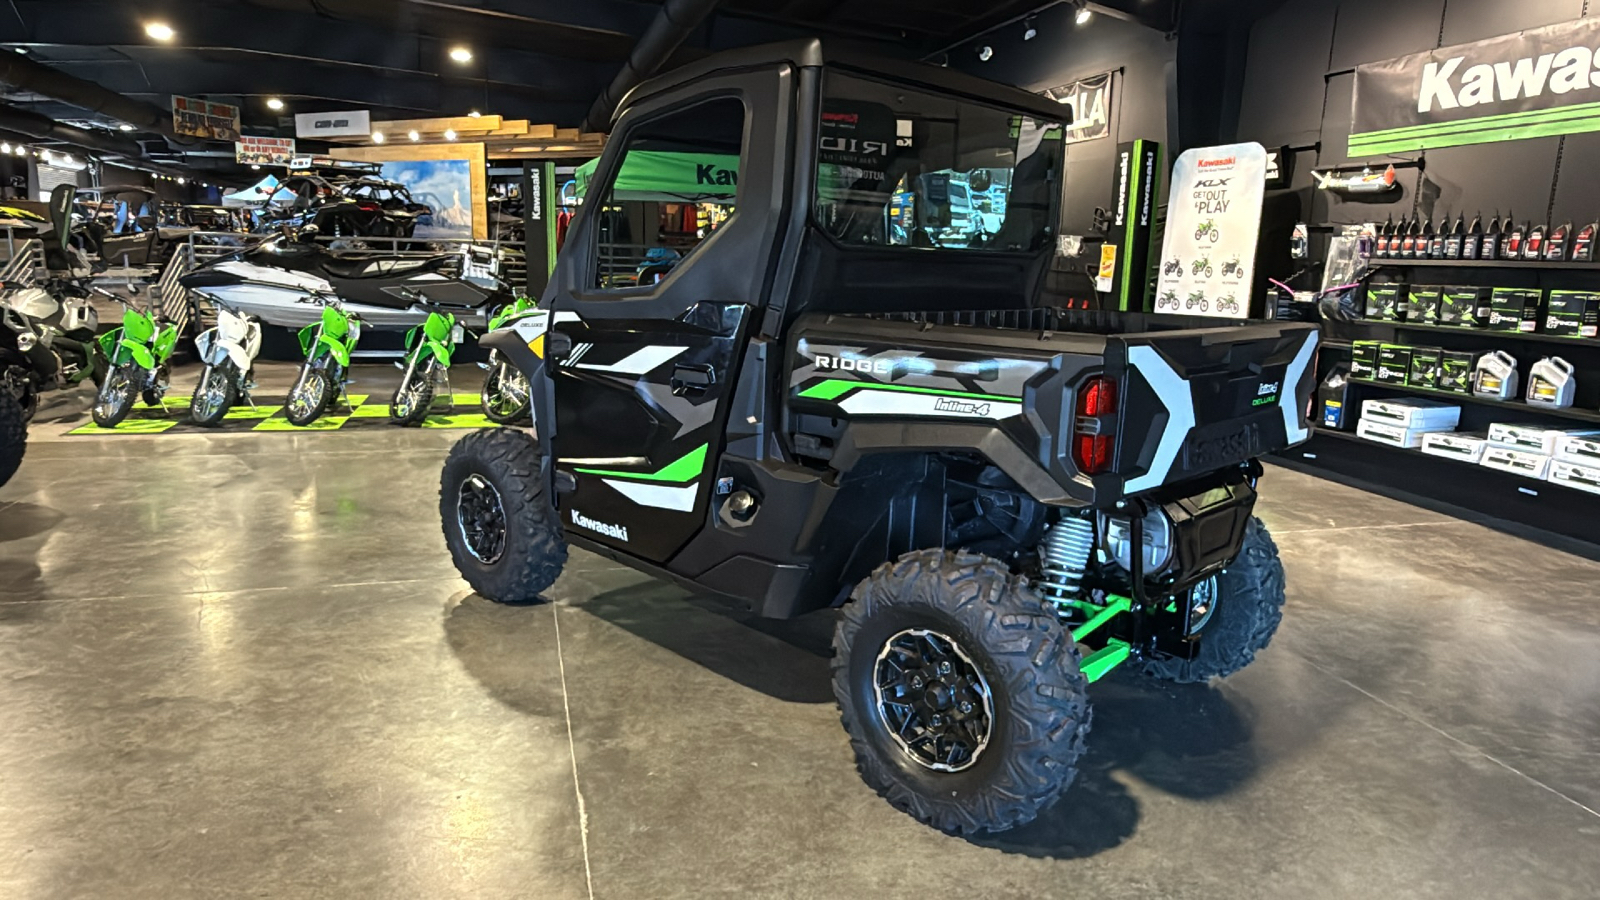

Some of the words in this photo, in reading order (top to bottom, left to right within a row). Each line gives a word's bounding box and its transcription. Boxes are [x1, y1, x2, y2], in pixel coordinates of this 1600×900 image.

[1197, 156, 1236, 168] Kawasaki
[1115, 152, 1129, 226] Kawasaki
[1141, 152, 1154, 226] Kawasaki
[1193, 177, 1234, 188] KLX
[532, 168, 541, 220] Kawasaki
[1193, 191, 1206, 199] GET
[1206, 190, 1227, 201] OUT
[1198, 200, 1230, 214] PLAY
[815, 355, 888, 374] RIDGE
[934, 398, 991, 416] Inline-4
[1252, 395, 1276, 406] DELUXE
[571, 508, 629, 542] Kawasaki
